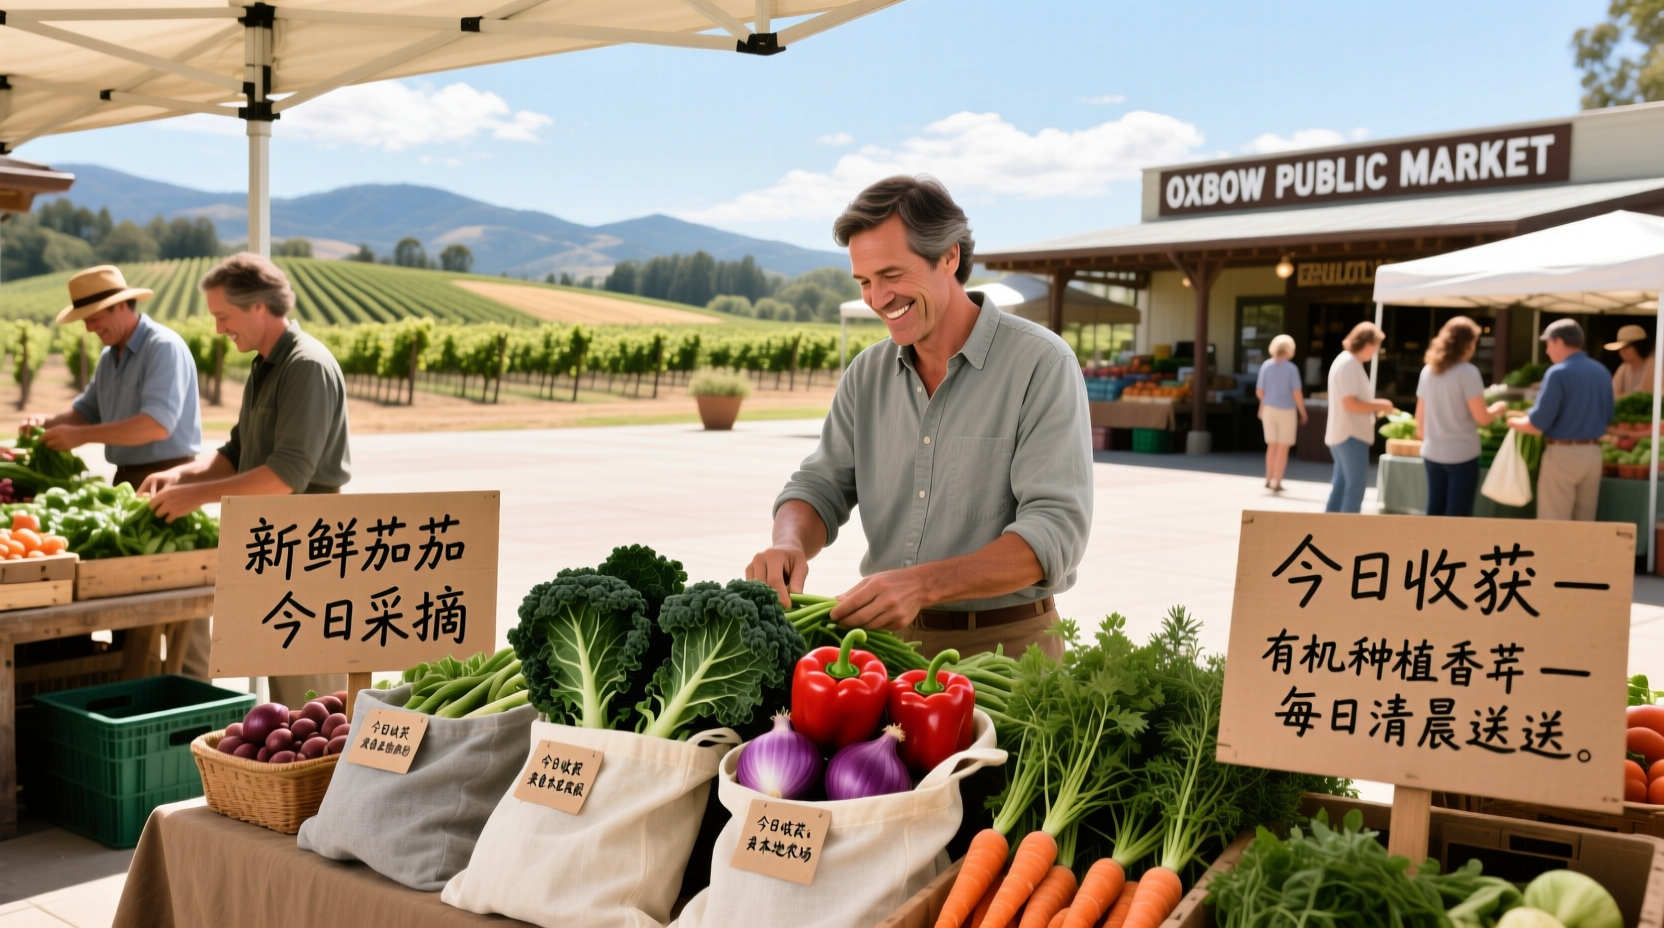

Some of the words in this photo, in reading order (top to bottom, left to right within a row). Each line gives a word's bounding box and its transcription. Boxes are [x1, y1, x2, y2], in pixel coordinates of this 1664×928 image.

[1165, 166, 1266, 209] OXBOW
[1275, 152, 1388, 199] PUBLIC
[1400, 134, 1555, 188] MARKET
[245, 514, 465, 580] 新鲜茄茄
[261, 585, 467, 649] 今日采摘
